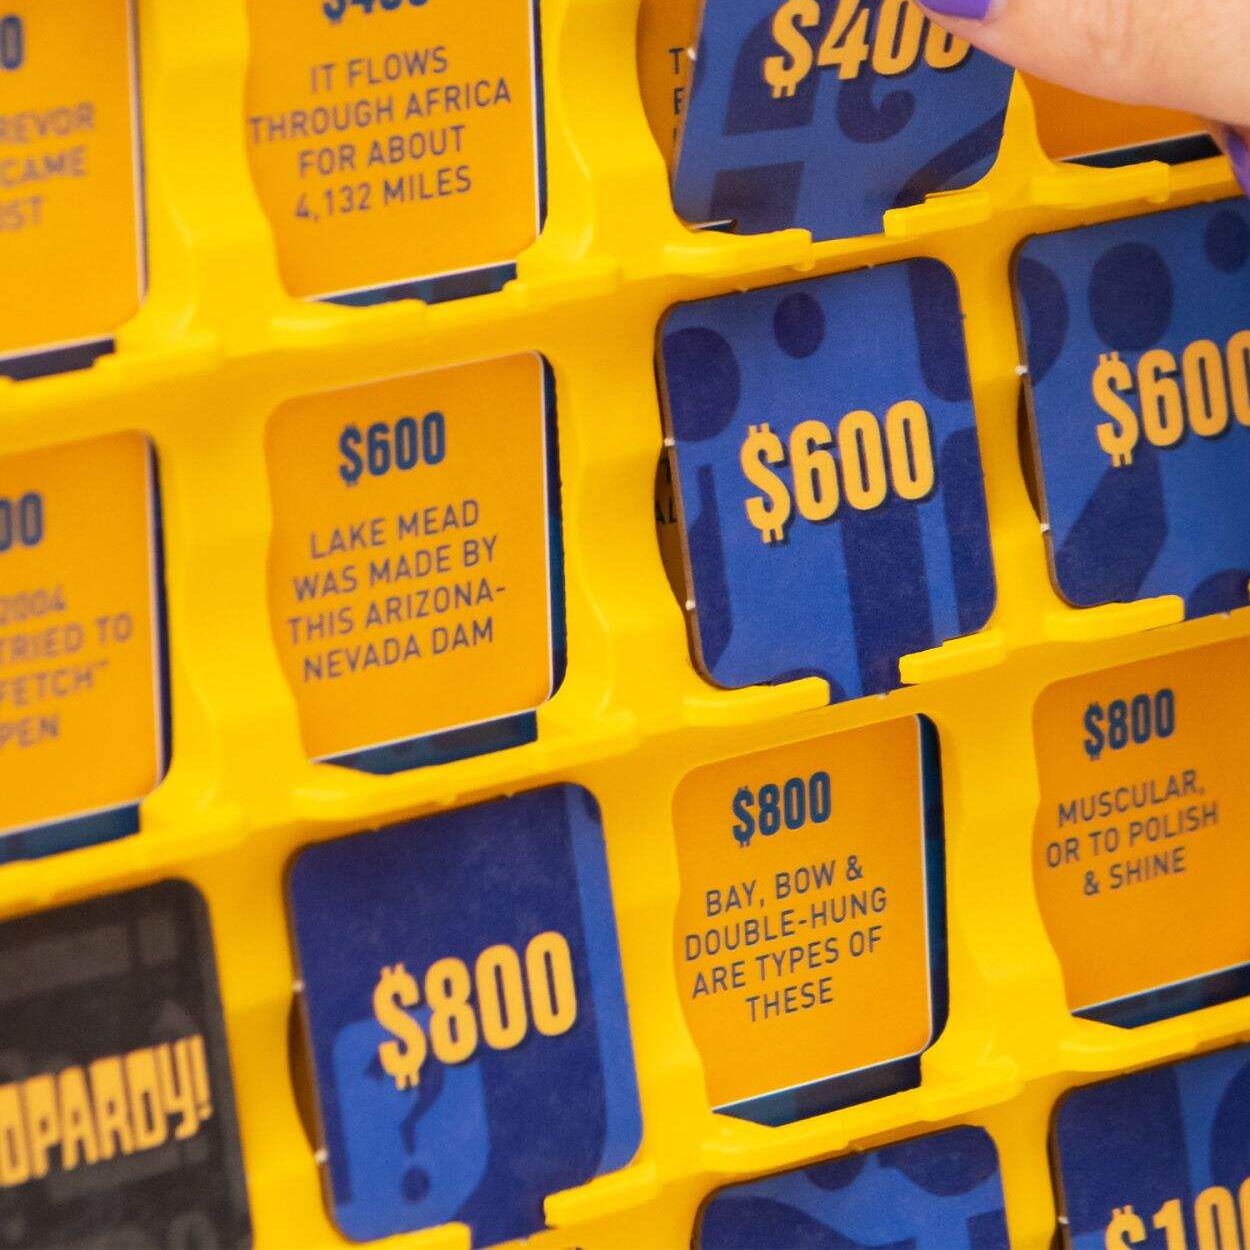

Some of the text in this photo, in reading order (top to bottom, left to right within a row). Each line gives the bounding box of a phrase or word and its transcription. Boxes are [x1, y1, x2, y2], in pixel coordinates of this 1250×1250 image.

[310, 45, 449, 93] IT FLOWS
[248, 77, 512, 143] THROUGH AFRICA
[299, 124, 465, 178] FOR ABOUT
[294, 164, 472, 221] 4,132 MILES
[338, 411, 446, 485] $600
[739, 399, 934, 544] $600
[311, 499, 480, 560] LAKE MEAD
[293, 534, 498, 602] WAS MADE BY
[94, 611, 134, 644] TO
[286, 577, 506, 646] THIS ARIZONA-
[303, 616, 494, 682] NEVADA DAM
[1083, 687, 1176, 760] $800
[732, 771, 832, 846] $800
[1058, 769, 1205, 828] MUSCULAR,
[1046, 801, 1219, 869] OR TO POLISH
[706, 854, 863, 918] BAY, BOW &
[1083, 845, 1186, 897] & SHINE
[684, 886, 888, 962] DOUBLE-HUNG
[692, 924, 883, 999] ARE TYPES OF
[372, 930, 577, 1090] $800
[744, 976, 834, 1022] THESE
